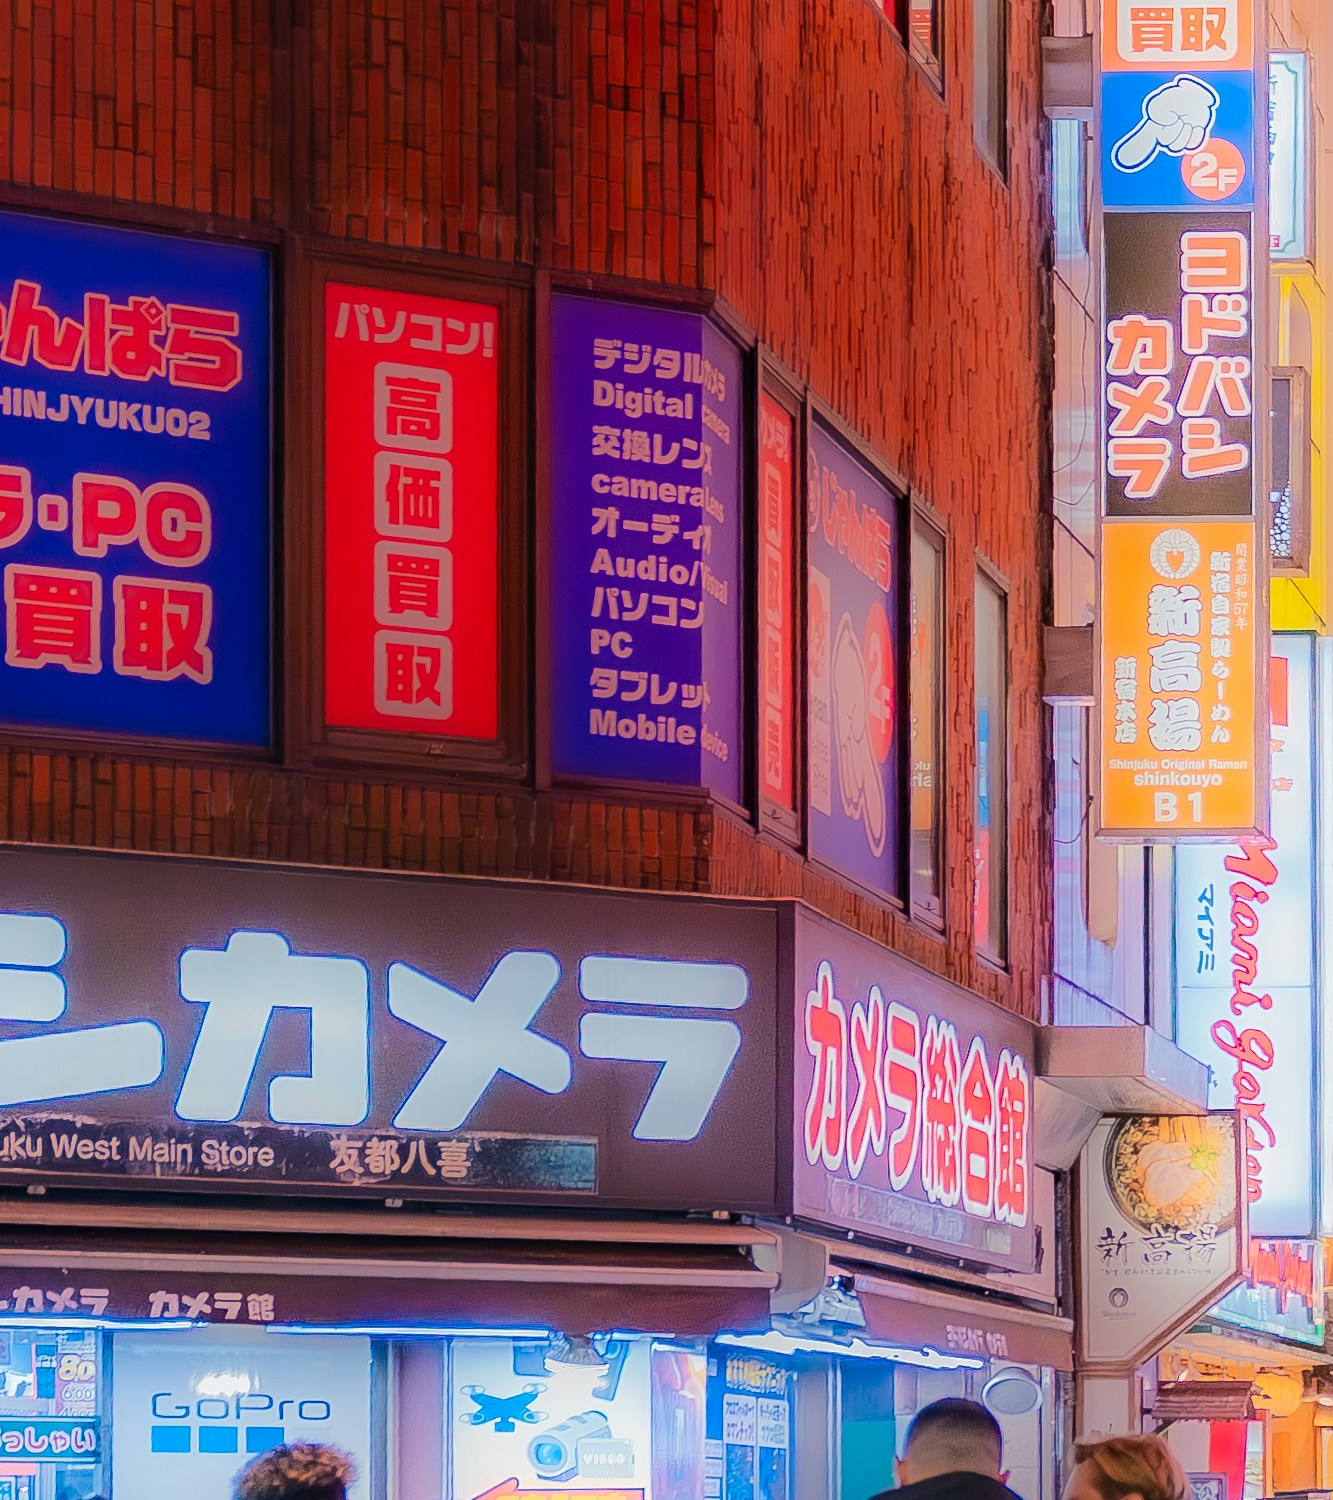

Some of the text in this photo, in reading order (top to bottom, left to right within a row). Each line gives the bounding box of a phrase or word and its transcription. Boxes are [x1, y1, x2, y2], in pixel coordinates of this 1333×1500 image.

[1129, 6, 1227, 54] 買取
[1189, 152, 1239, 192] 2F
[0, 278, 243, 393] んぱら
[335, 302, 494, 358] パソコン!
[1176, 229, 1254, 482] ヨドバシ
[592, 379, 694, 420] Digital
[1105, 311, 1176, 500] カメラ
[380, 370, 449, 714] 高価買取
[4, 563, 213, 685] 買取
[591, 586, 706, 629] パソコン
[590, 628, 634, 660] PC
[589, 666, 712, 714] タブレット
[1112, 654, 1138, 745] 新宿本店
[589, 708, 697, 747] Mobile
[1108, 757, 1249, 773] Shinjuku Original Ramen
[1132, 771, 1224, 789] shinkouyo
[1195, 882, 1217, 976] マイアミ
[804, 959, 1030, 1230] カメラ総合館
[51, 1132, 276, 1170] West Main Store
[329, 1136, 472, 1180] 友都八喜
[148, 1289, 277, 1323] カメラ館
[150, 1392, 332, 1422] GoPro
